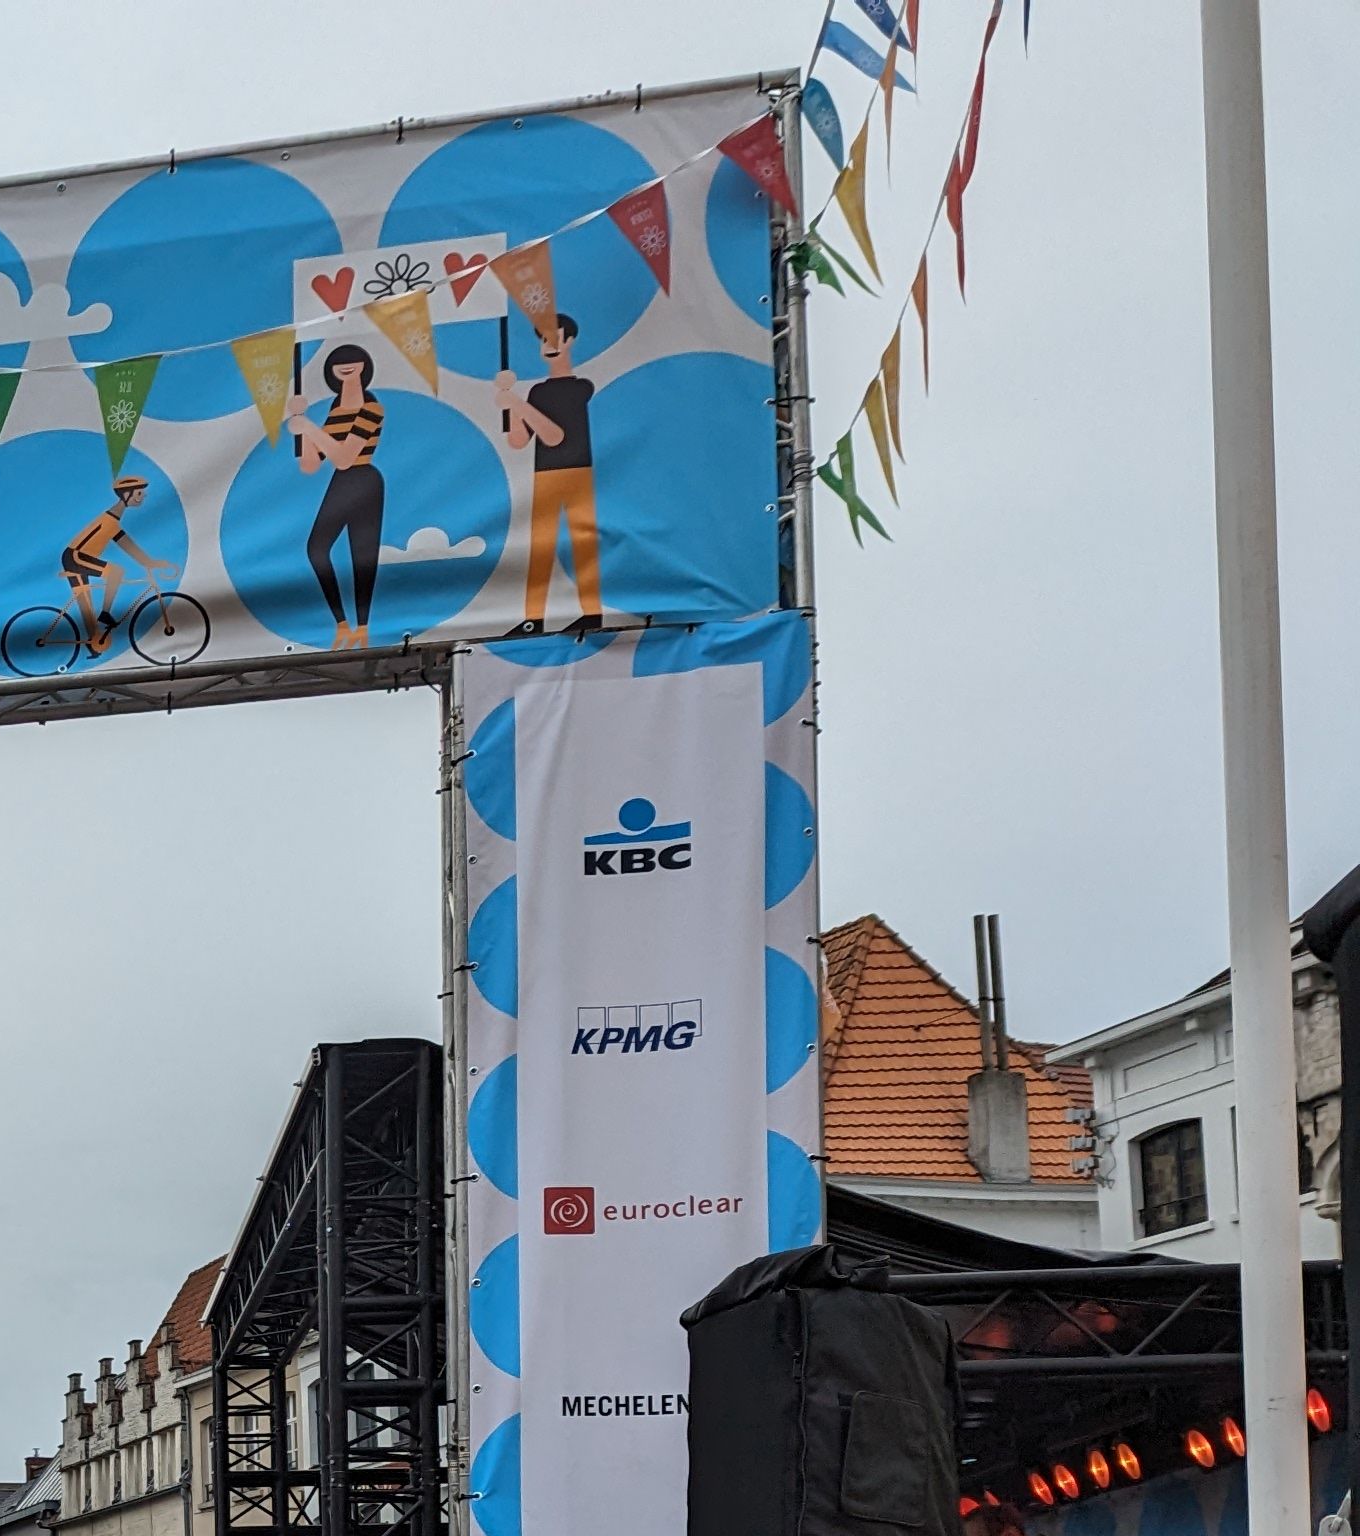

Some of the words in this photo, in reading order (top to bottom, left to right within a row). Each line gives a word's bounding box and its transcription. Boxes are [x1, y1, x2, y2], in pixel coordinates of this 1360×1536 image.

[583, 842, 692, 877] KBC
[563, 1019, 697, 1056] KPMG
[602, 1195, 744, 1221] euroclear
